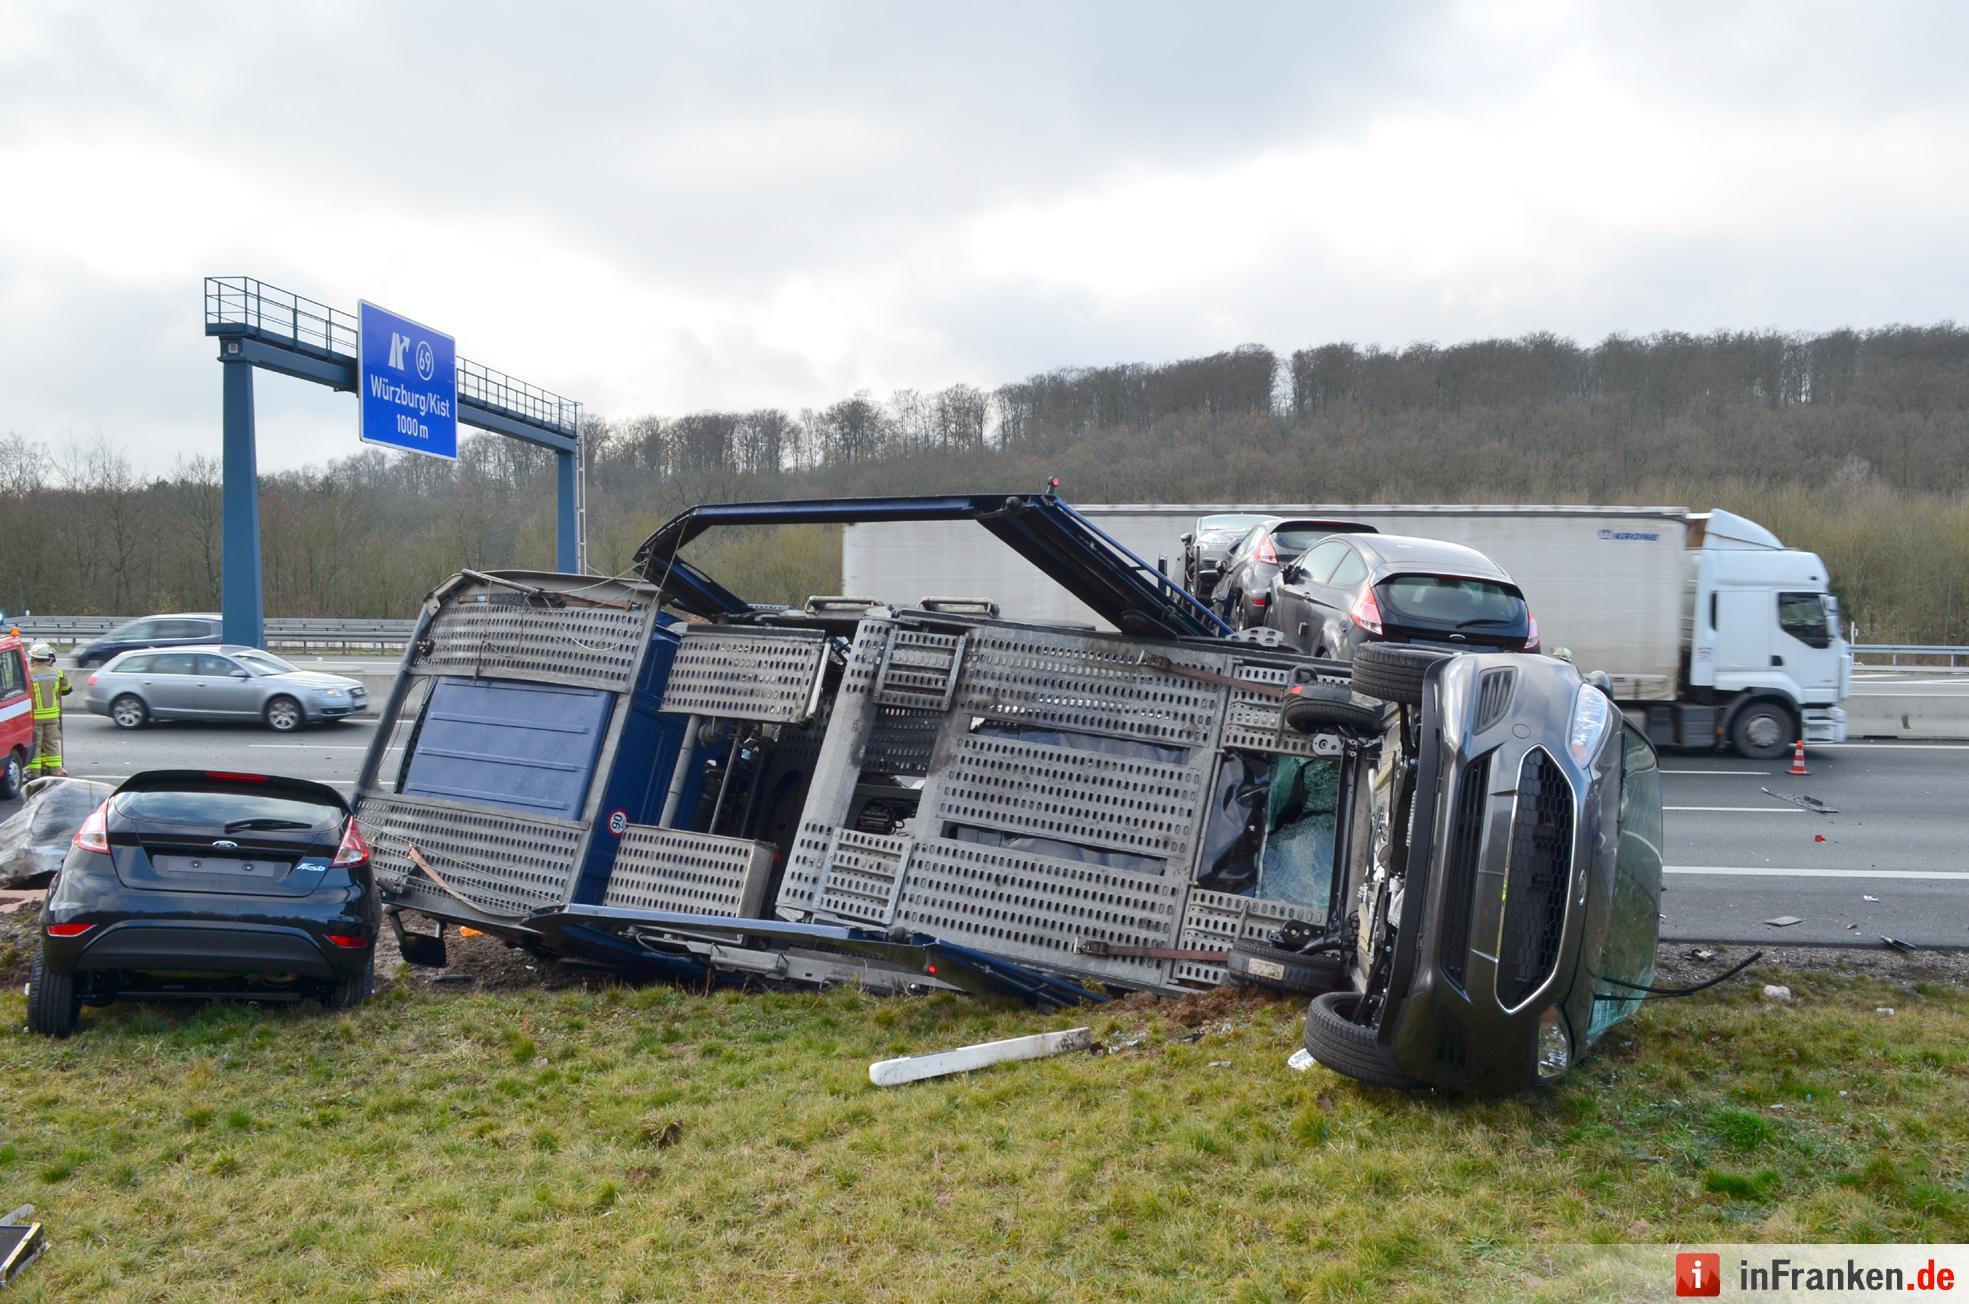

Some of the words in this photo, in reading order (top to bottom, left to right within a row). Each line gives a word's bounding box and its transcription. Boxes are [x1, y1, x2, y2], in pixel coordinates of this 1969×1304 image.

[418, 351, 431, 373] 69
[370, 374, 450, 418] Würzburg/Kist
[396, 413, 418, 437] 1000
[419, 425, 429, 439] m
[611, 813, 623, 830] 90
